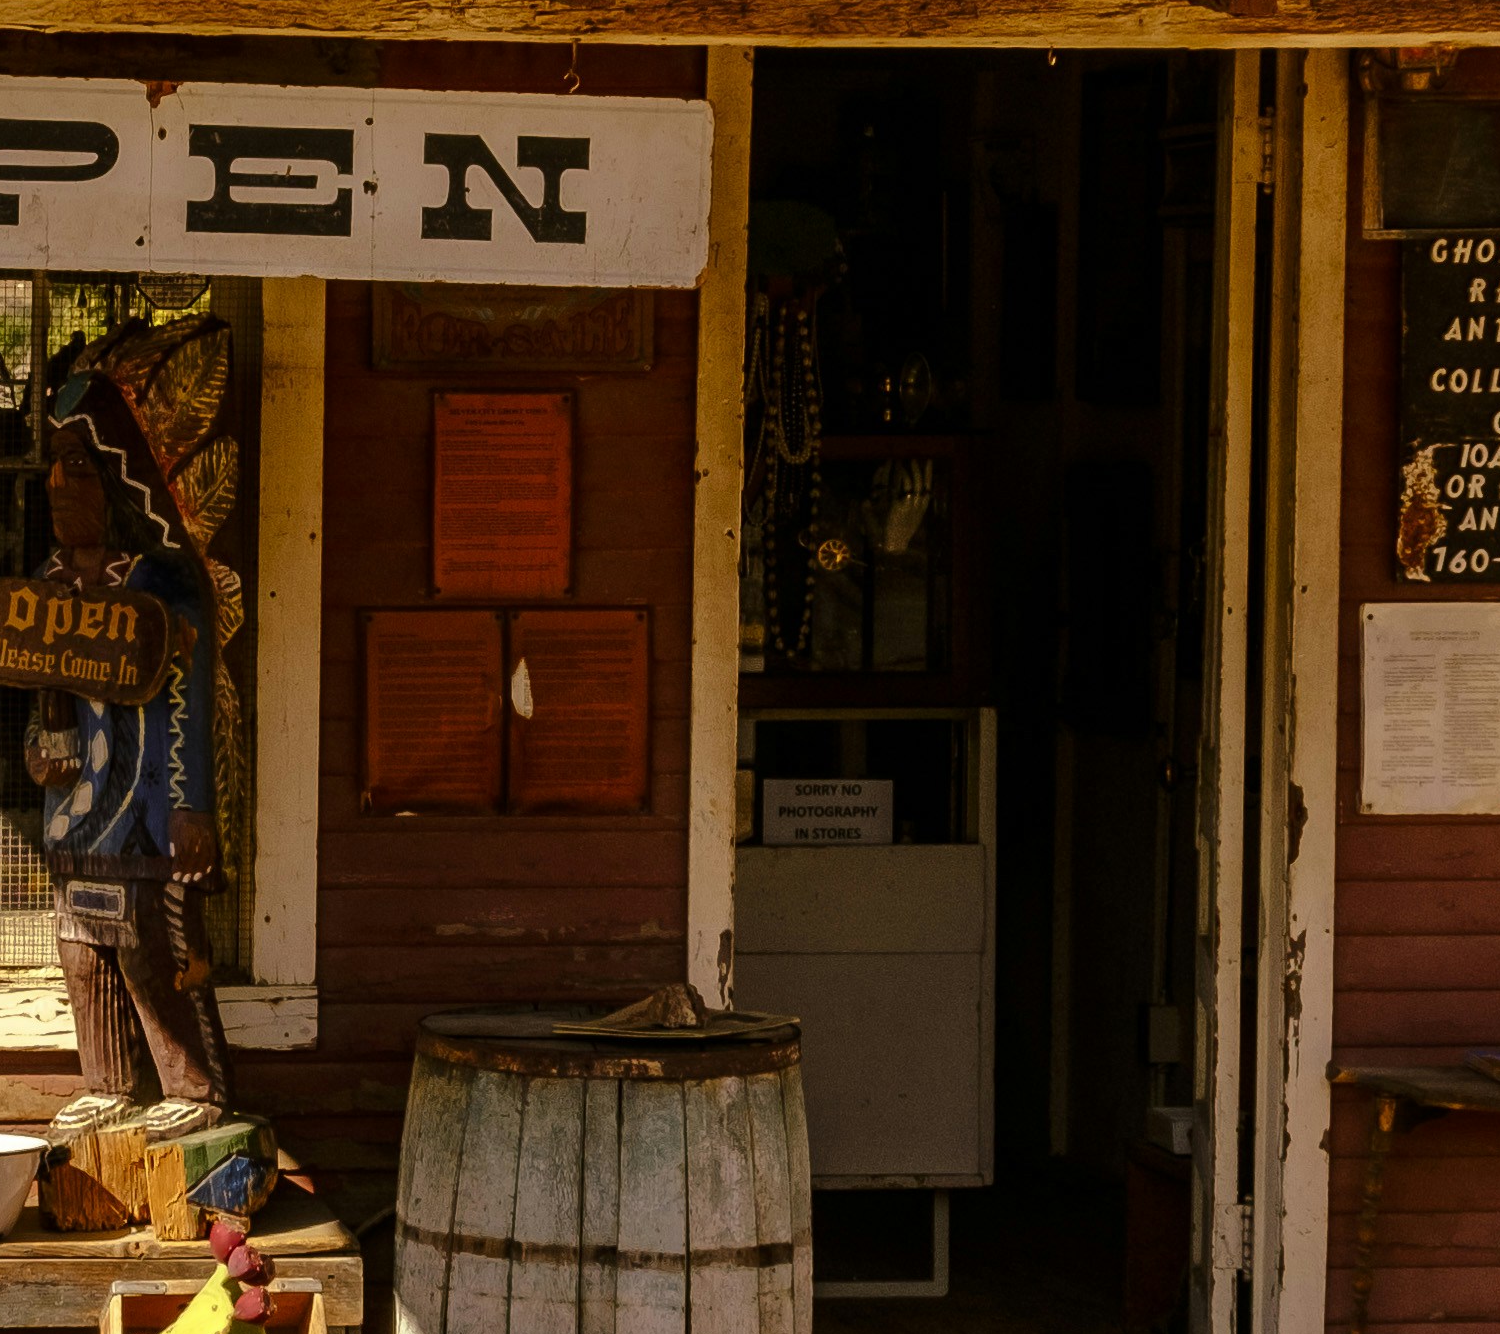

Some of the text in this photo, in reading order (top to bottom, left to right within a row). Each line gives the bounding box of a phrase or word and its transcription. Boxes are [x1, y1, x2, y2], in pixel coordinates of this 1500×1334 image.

[1446, 474, 1486, 499] OR
[3, 586, 140, 645] Open
[61, 649, 111, 683] Come
[118, 655, 139, 686] In
[795, 784, 863, 796] SORRY NO
[778, 806, 879, 818] PHOTOGRAPHY
[794, 827, 862, 840] IN STORES
